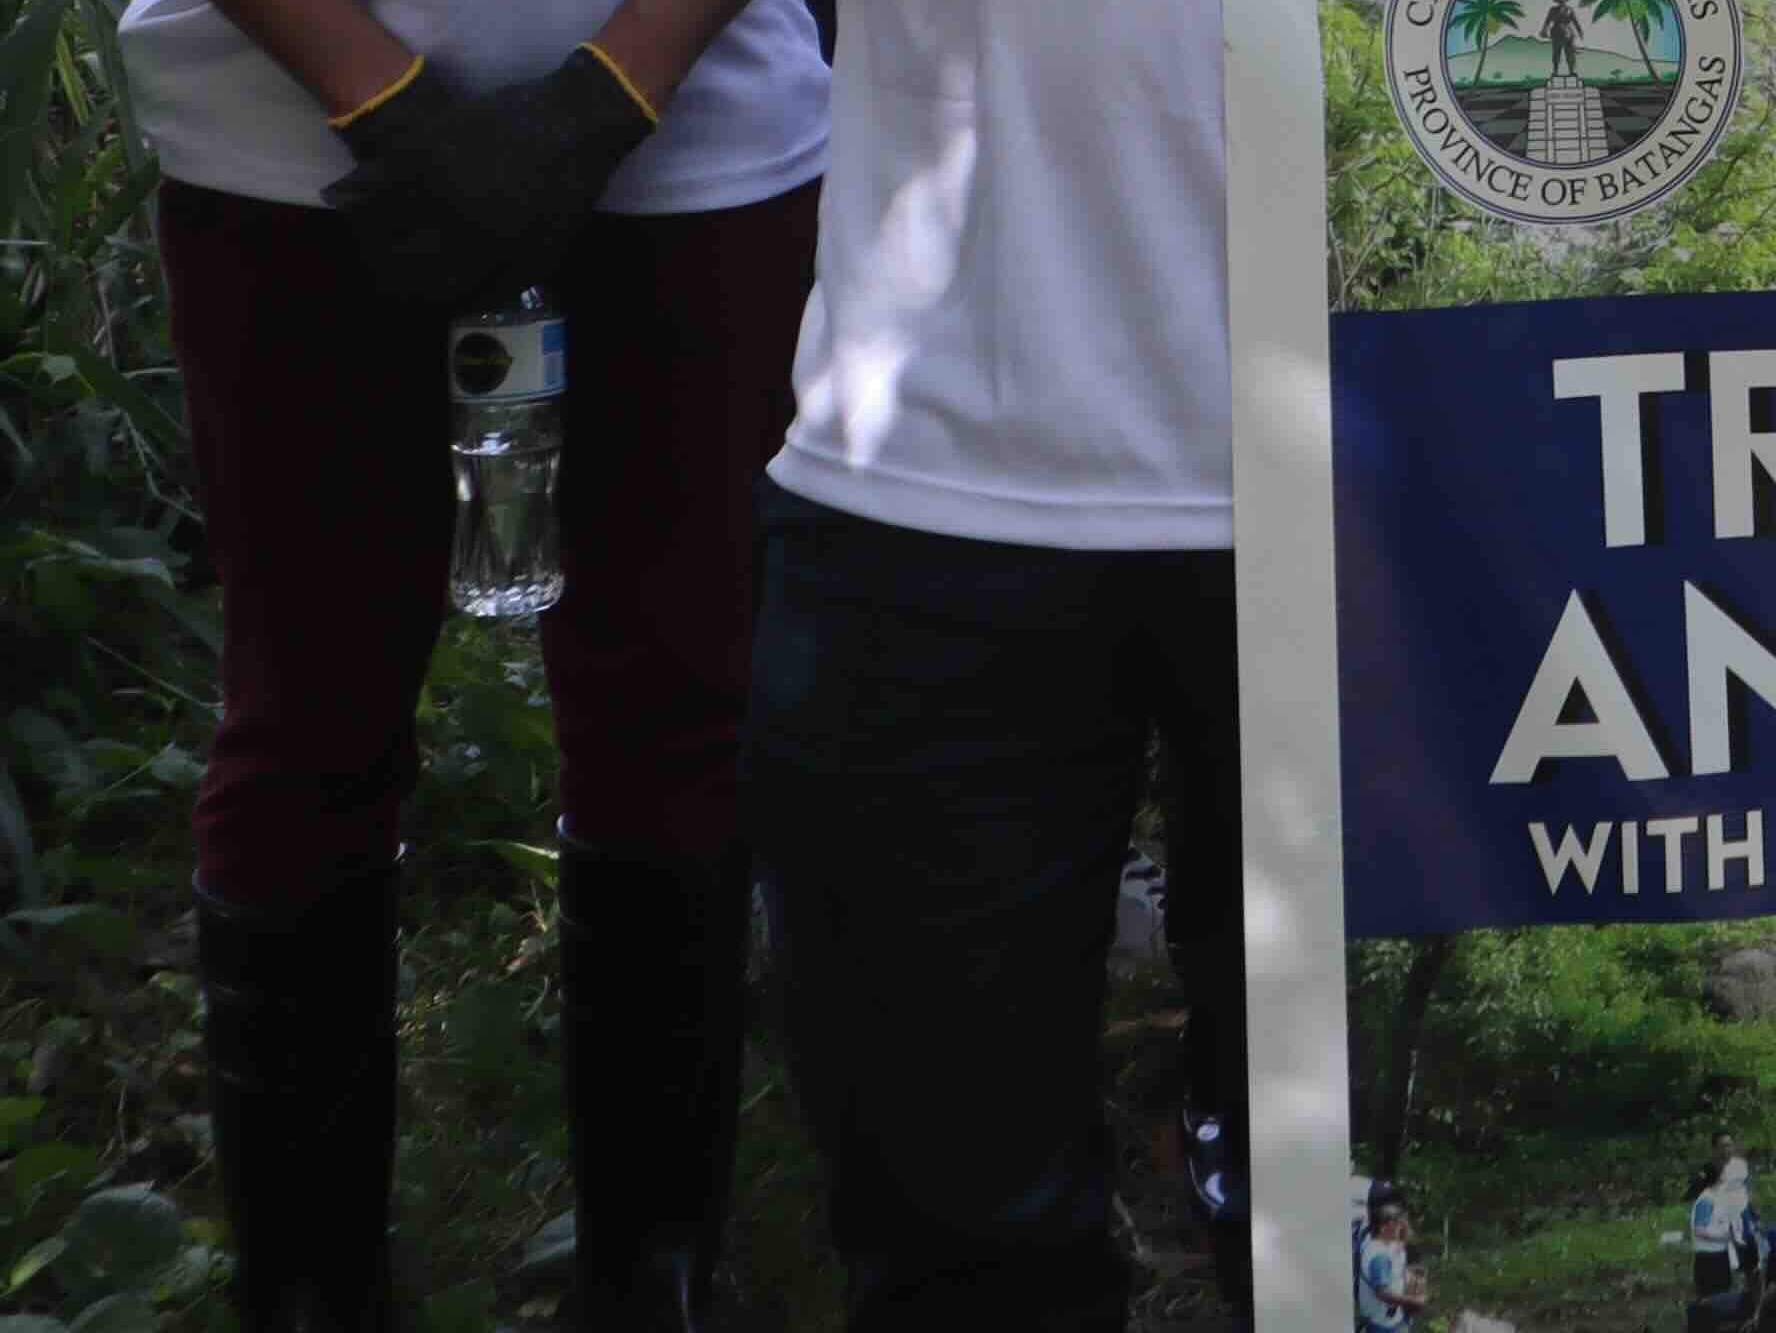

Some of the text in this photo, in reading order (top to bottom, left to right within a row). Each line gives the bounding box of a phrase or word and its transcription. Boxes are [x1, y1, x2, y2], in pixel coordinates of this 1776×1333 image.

[1403, 55, 1726, 206] PROVINCE OF BATANGAS
[1528, 809, 1766, 894] WITH
